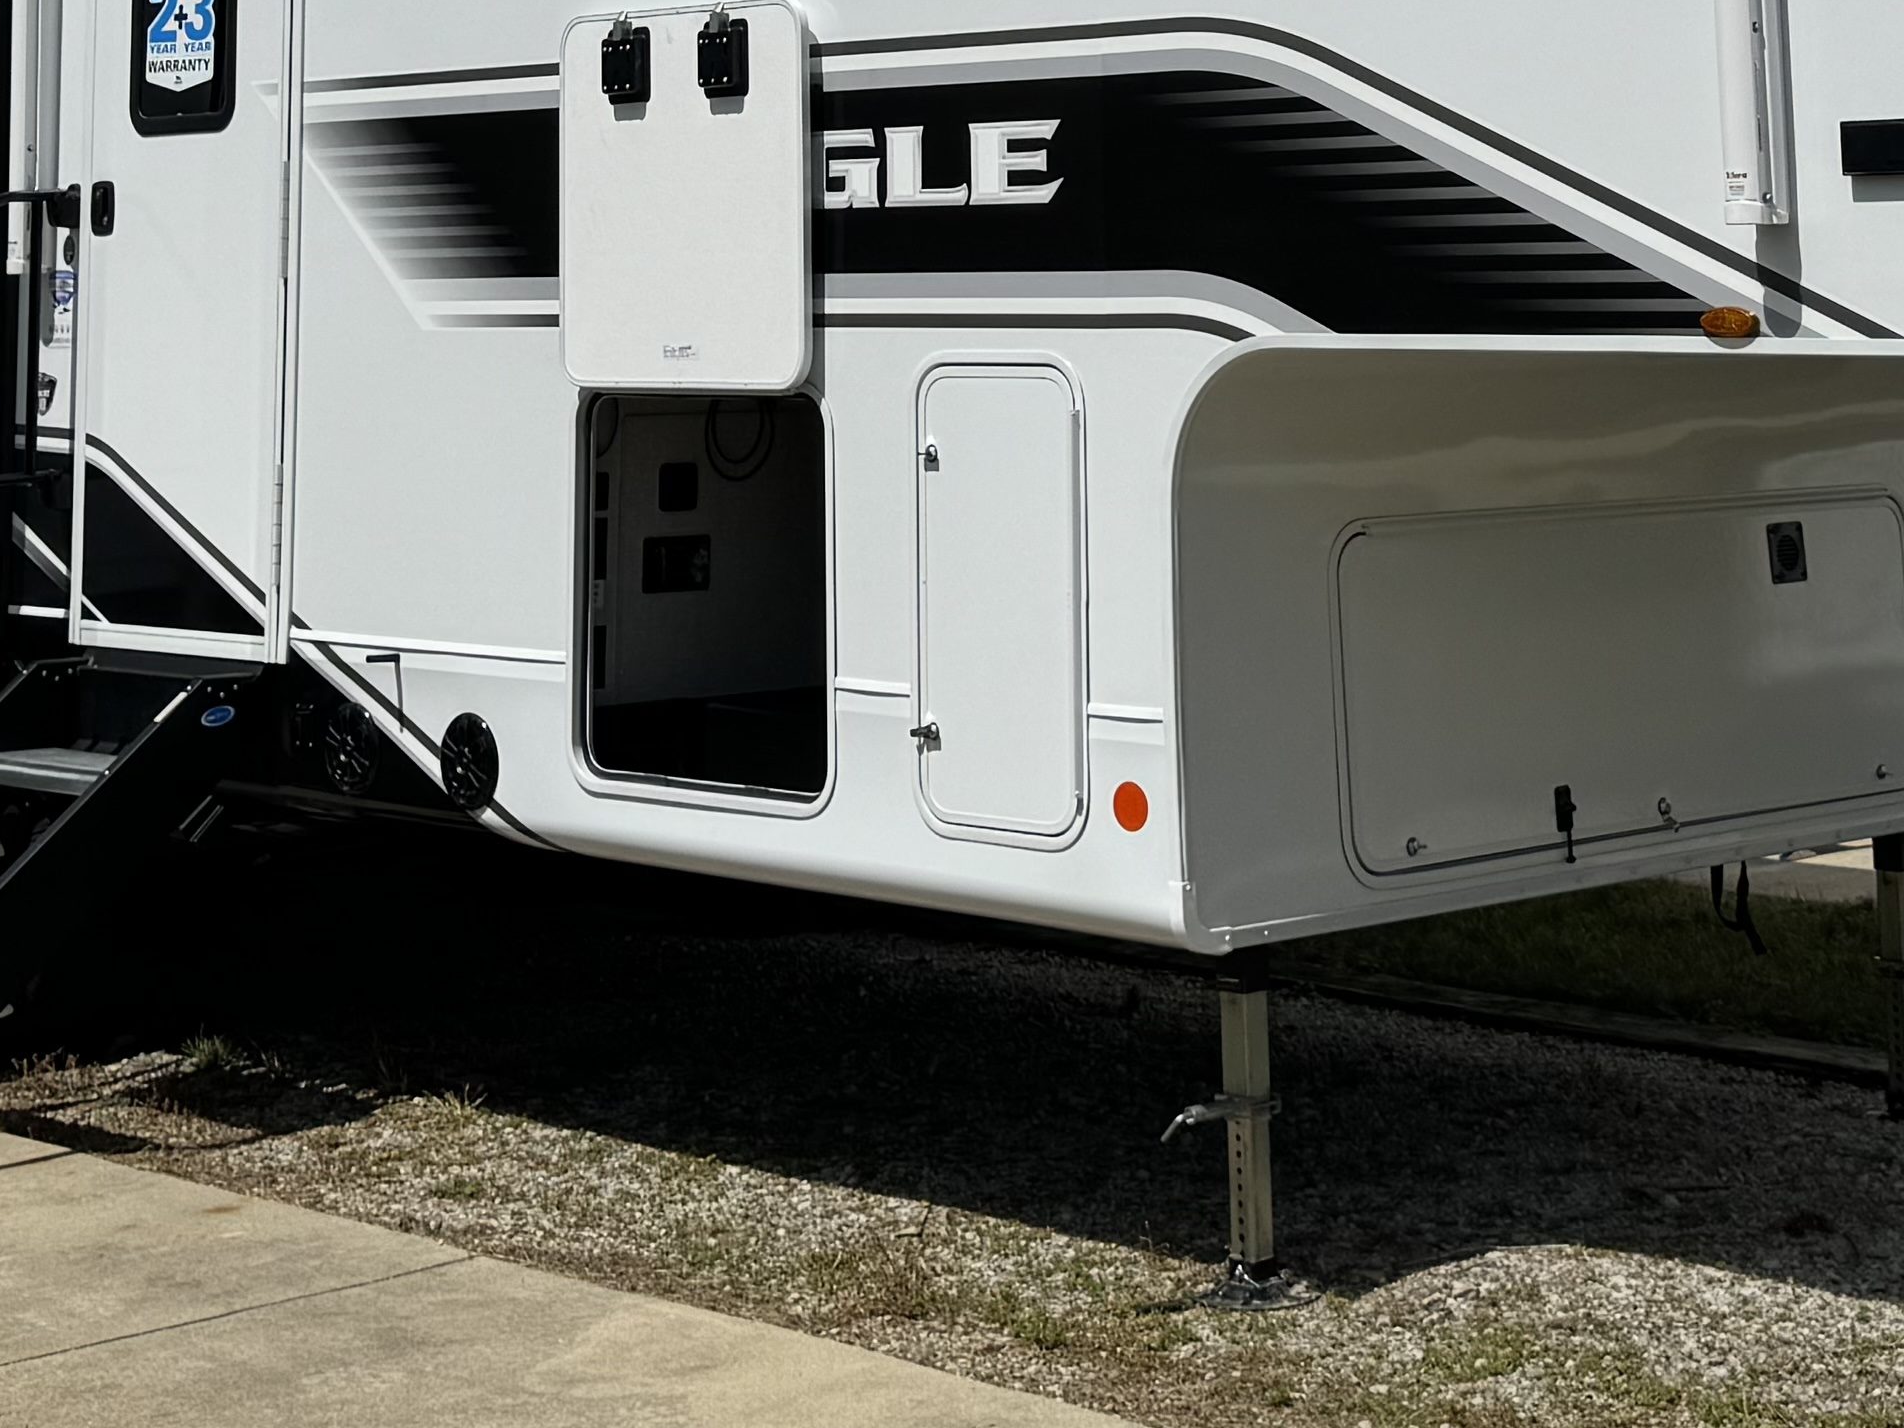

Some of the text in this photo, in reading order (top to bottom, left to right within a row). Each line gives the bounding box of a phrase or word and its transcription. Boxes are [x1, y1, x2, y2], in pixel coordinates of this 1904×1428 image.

[149, 41, 211, 54] YEAR YEAR
[148, 58, 211, 73] WARRANTY
[812, 119, 1064, 209] GLE
